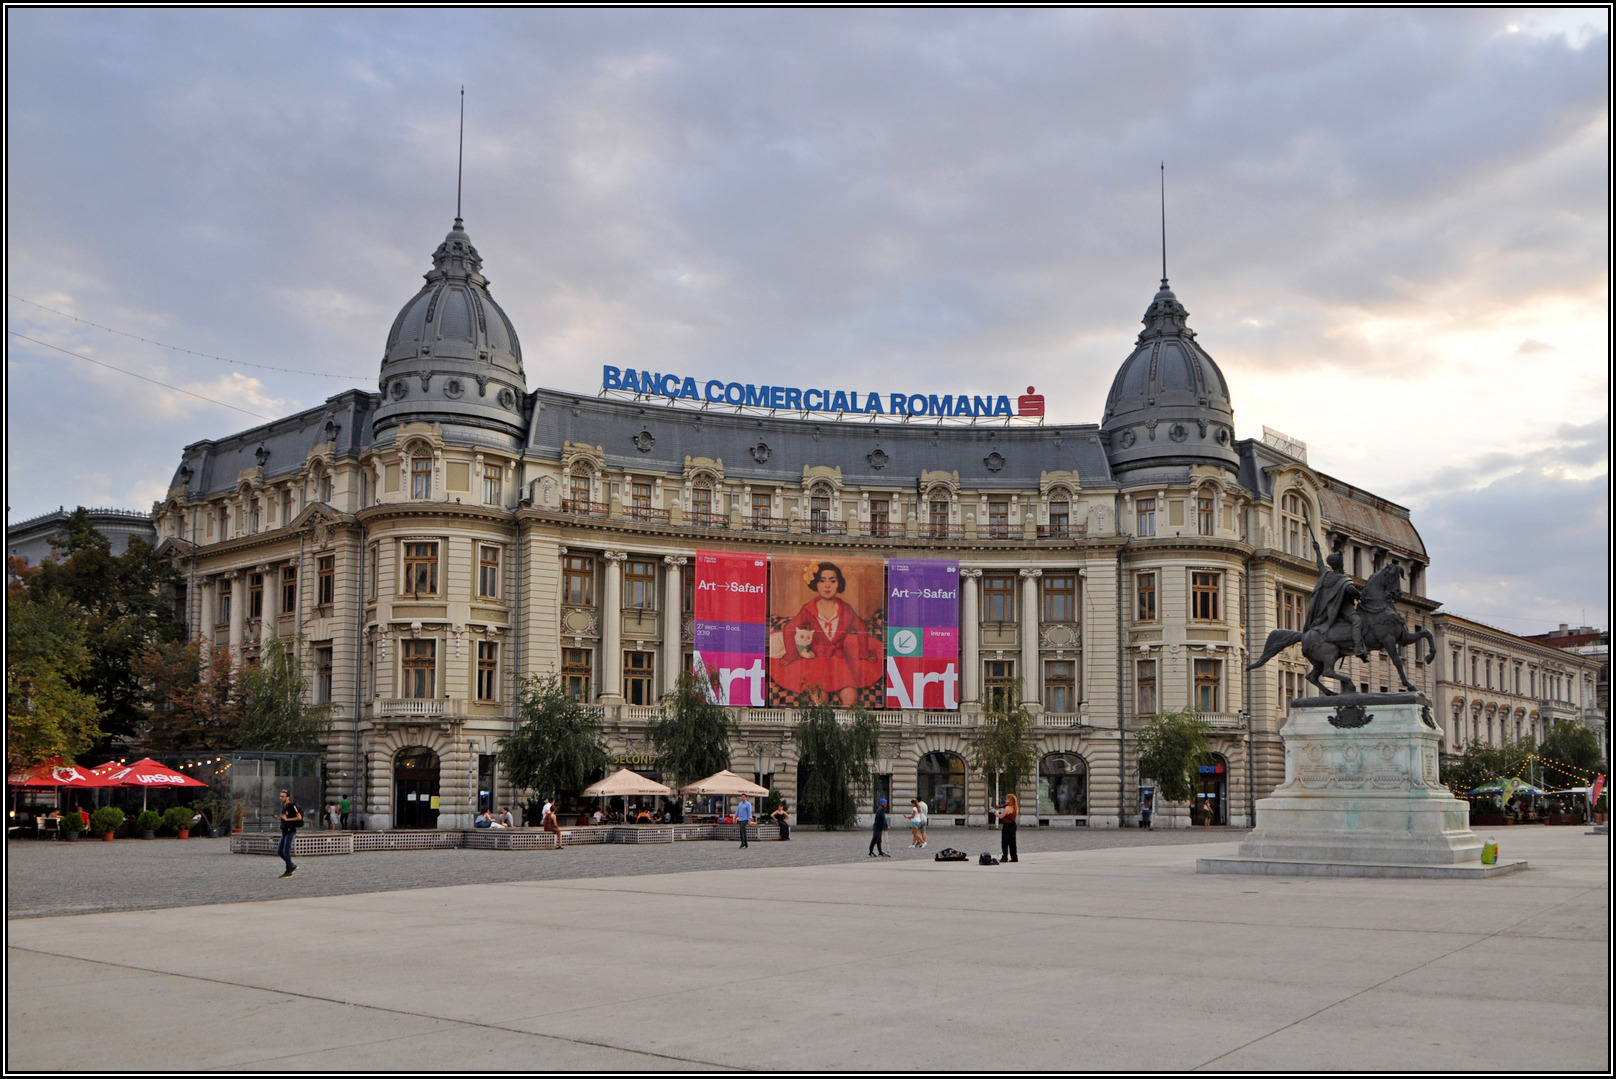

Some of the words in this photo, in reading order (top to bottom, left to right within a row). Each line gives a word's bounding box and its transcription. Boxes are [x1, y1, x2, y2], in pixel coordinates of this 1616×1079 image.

[603, 365, 700, 400] BANCA
[704, 380, 884, 415] COMERCIALA
[890, 393, 1013, 416] ROMANA
[698, 580, 716, 590] Art
[730, 582, 764, 593] Safari
[891, 588, 909, 598] Art
[923, 588, 956, 599] Safari
[887, 656, 958, 709] Art
[612, 754, 656, 765] SECOND
[1200, 765, 1215, 773] BCR
[136, 774, 184, 783] URSUS
